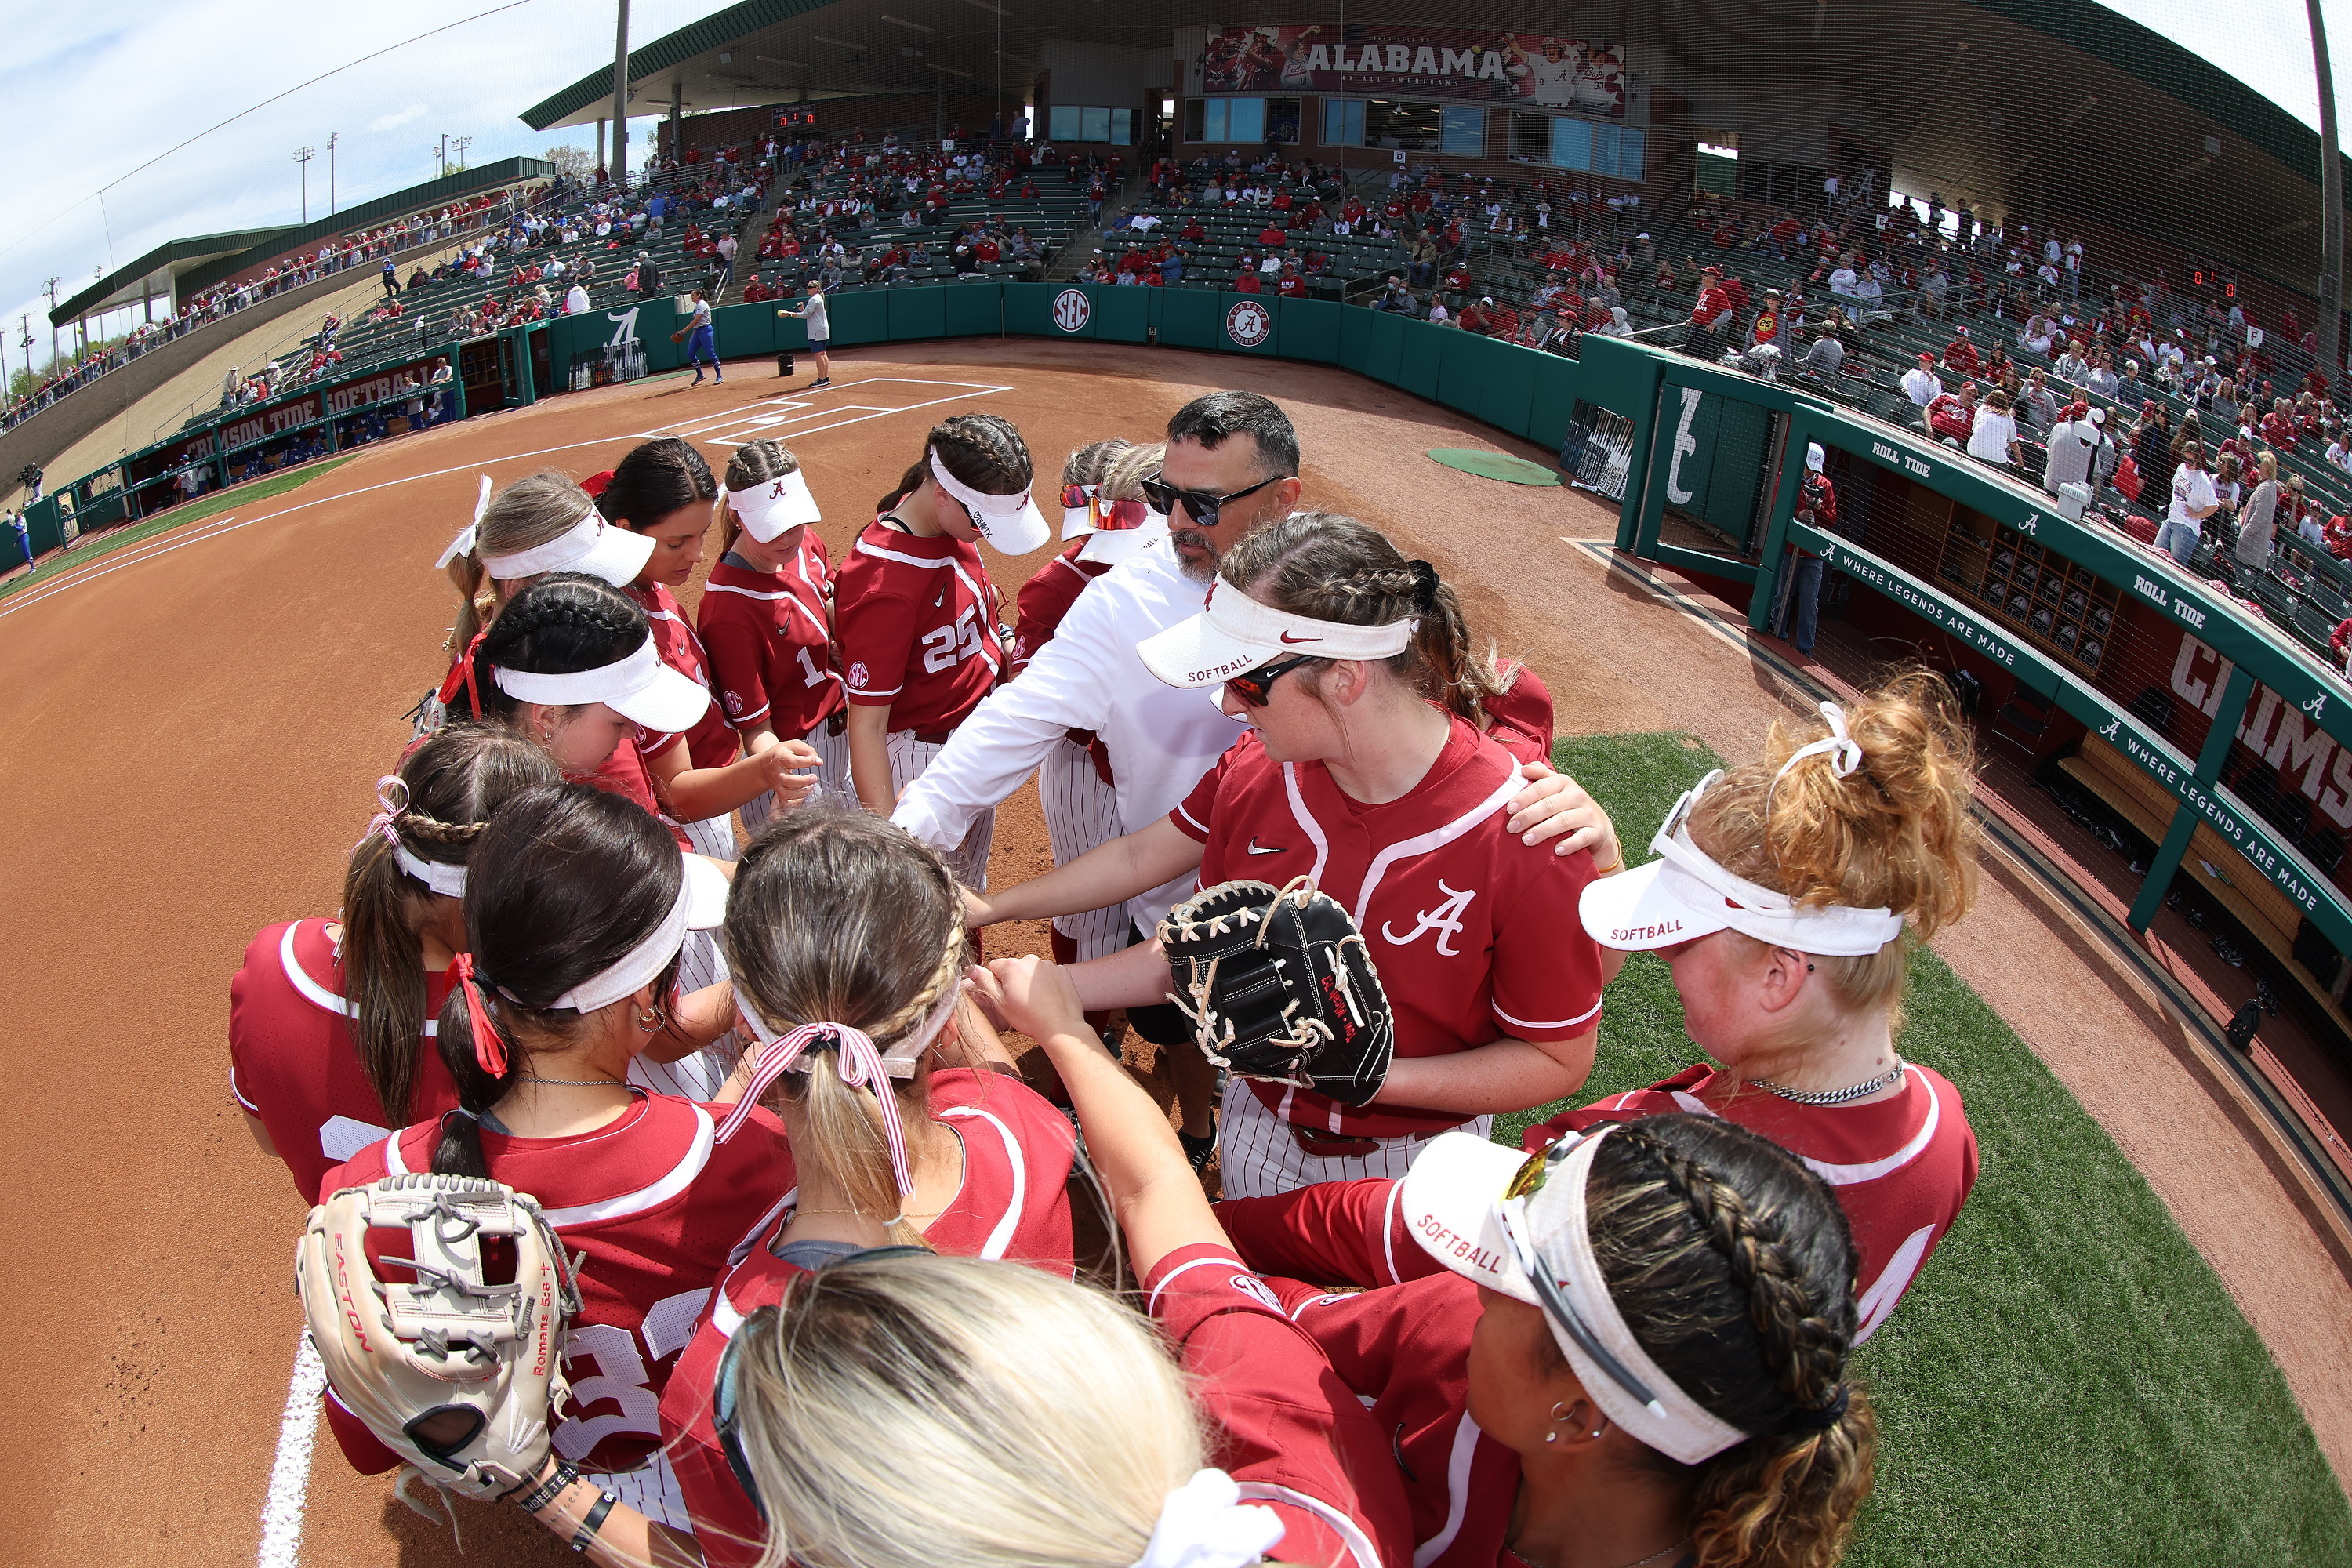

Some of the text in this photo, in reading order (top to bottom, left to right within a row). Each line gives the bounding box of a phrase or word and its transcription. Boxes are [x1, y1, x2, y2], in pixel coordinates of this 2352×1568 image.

[1305, 44, 1506, 80] ALABAMA
[1390, 77, 1459, 87] AMERICANS
[780, 117, 787, 126] 0
[807, 114, 814, 123] 0
[191, 280, 227, 301] CONCESSIONS
[2194, 271, 2202, 285] 0
[2227, 283, 2234, 297] 0
[1056, 292, 1087, 328] SEC
[1229, 303, 1267, 322] ALABAMA
[1238, 314, 1256, 332] A
[1759, 319, 1773, 328] 25
[603, 307, 640, 366] A
[1229, 325, 1267, 344] CRIMSON TIDE
[2251, 330, 2258, 341] F
[269, 400, 317, 431] TIDE
[1871, 441, 1931, 479] ROLL TIDE
[769, 480, 786, 499] A
[2018, 510, 2039, 536] A
[1820, 541, 2016, 666] A WHERE LEGENDS ARE MADE
[2133, 574, 2206, 630] ROLL TIDE
[921, 604, 983, 674] 25
[797, 646, 826, 688] 1
[850, 662, 868, 688] SEC
[1188, 655, 1253, 682] SOFTBALL
[2303, 690, 2328, 720] A
[2170, 630, 2352, 829] CIMS
[2099, 717, 2317, 911] A WHERE LEGENDS ARE MADE
[1381, 878, 1477, 957] A
[1610, 919, 1683, 941] SOFTBALL
[1417, 1213, 1501, 1275] SOFTBALL
[334, 1232, 375, 1354] EASTON
[532, 1281, 550, 1377] Romans 5:8
